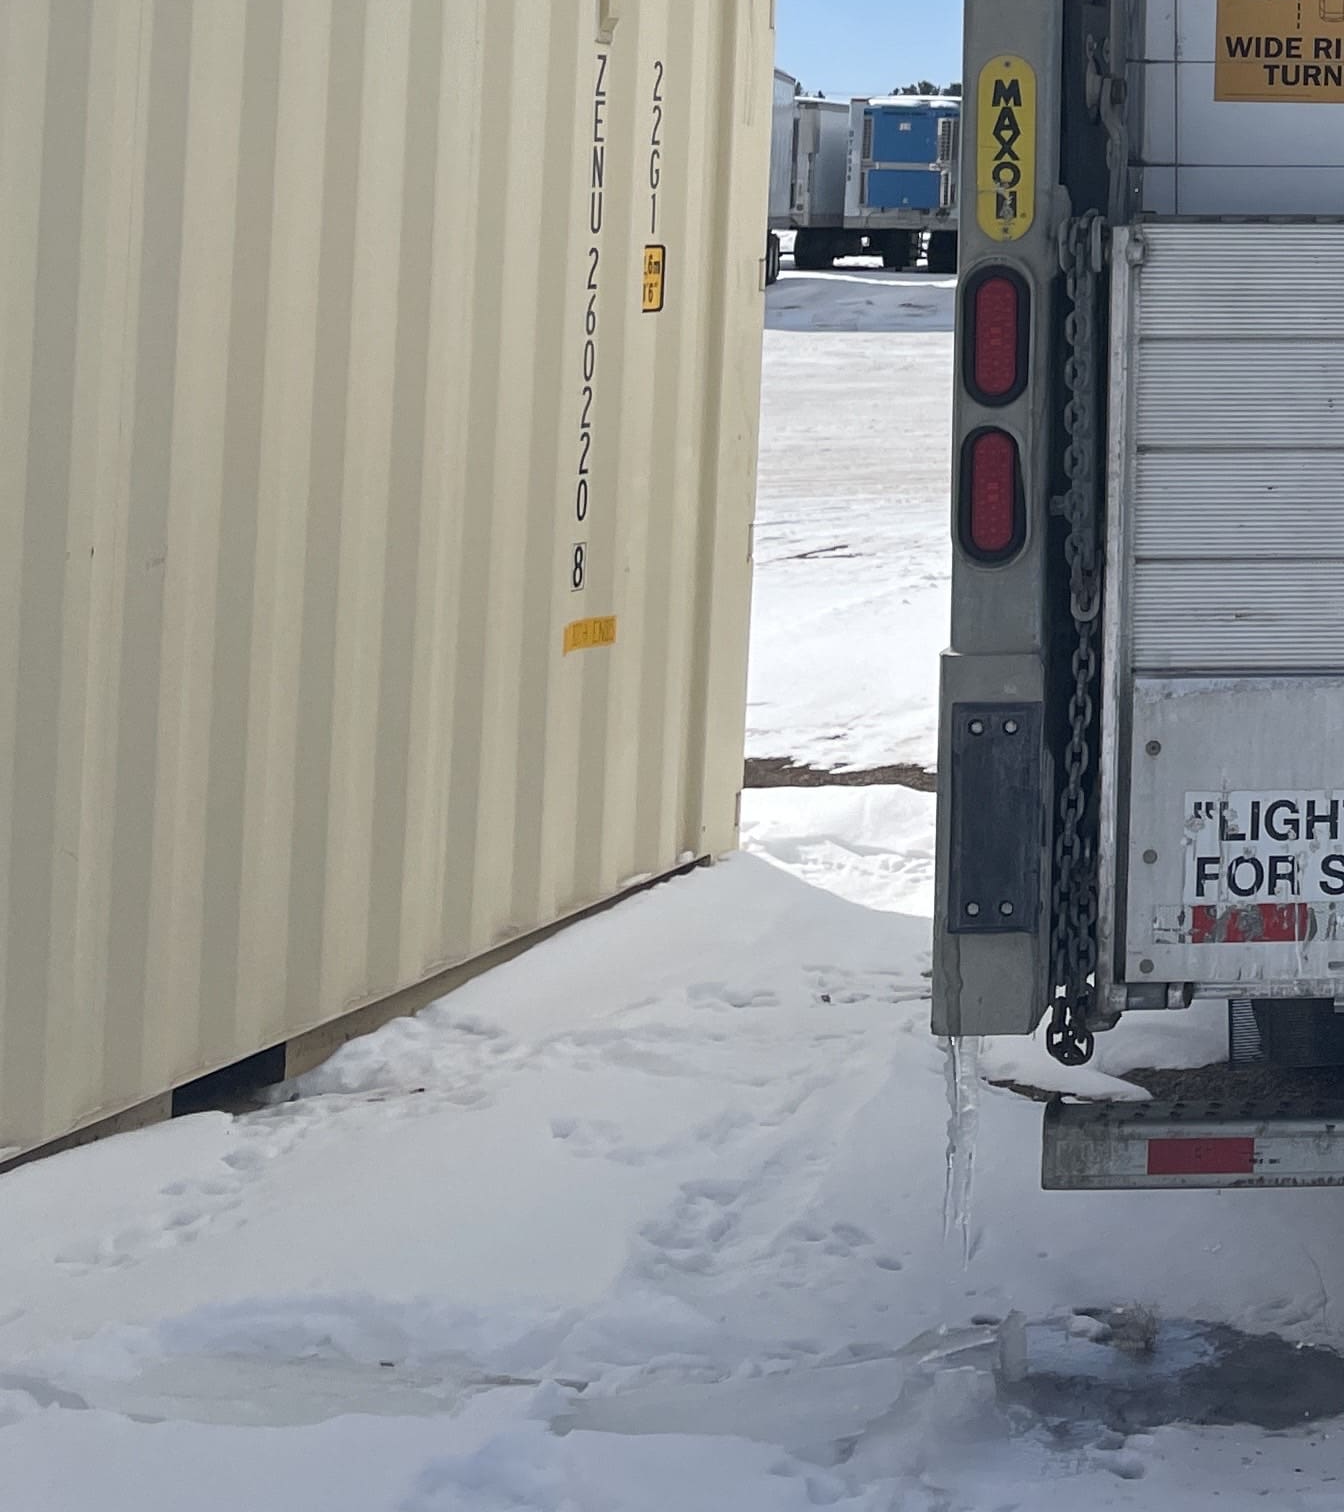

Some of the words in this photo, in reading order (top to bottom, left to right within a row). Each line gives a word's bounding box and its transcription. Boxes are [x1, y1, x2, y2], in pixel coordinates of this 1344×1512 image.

[1225, 36, 1303, 59] WIDE
[590, 54, 607, 234] ZENU
[650, 60, 663, 234] 22G1
[991, 78, 1022, 220] MAXON
[576, 247, 599, 522] 260220
[1194, 854, 1300, 897] FOR
